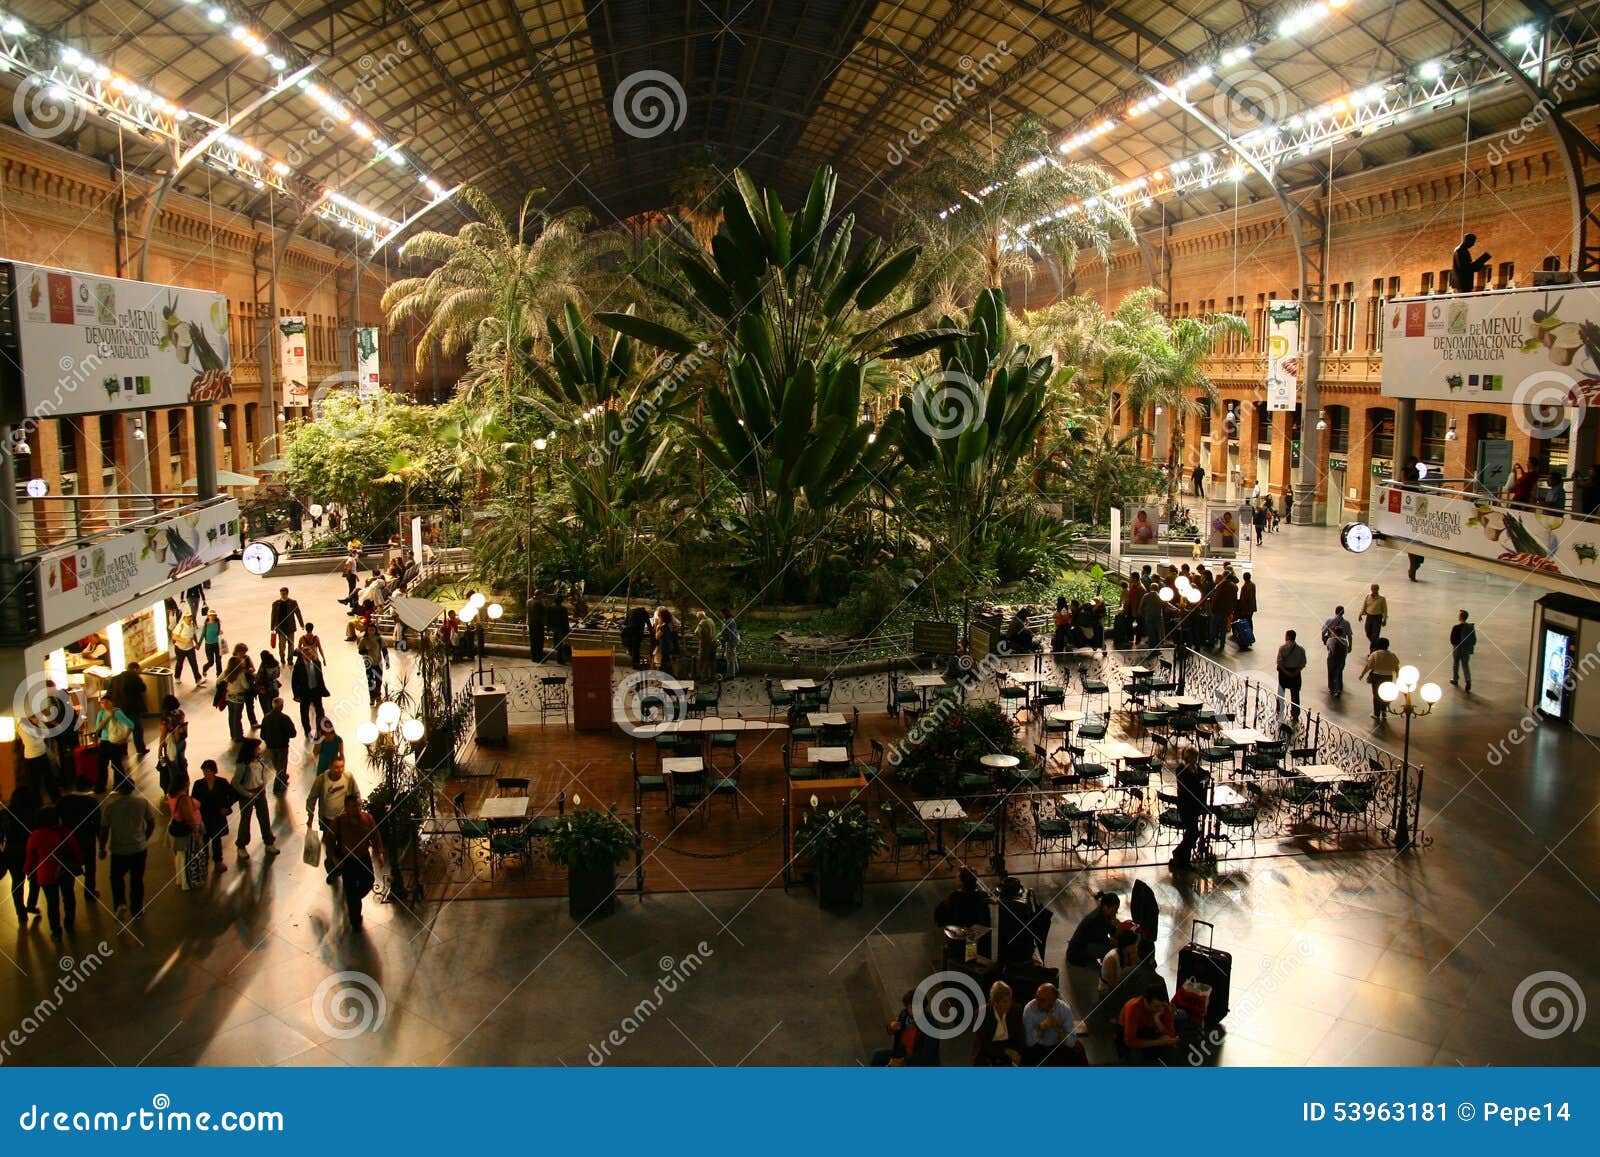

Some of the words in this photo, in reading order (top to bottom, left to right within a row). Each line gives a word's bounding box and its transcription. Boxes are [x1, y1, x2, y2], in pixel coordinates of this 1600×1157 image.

[85, 327, 160, 347] DENOMINACIONES
[1433, 334, 1523, 350] DENOMINACIONES
[1443, 349, 1453, 360] DE
